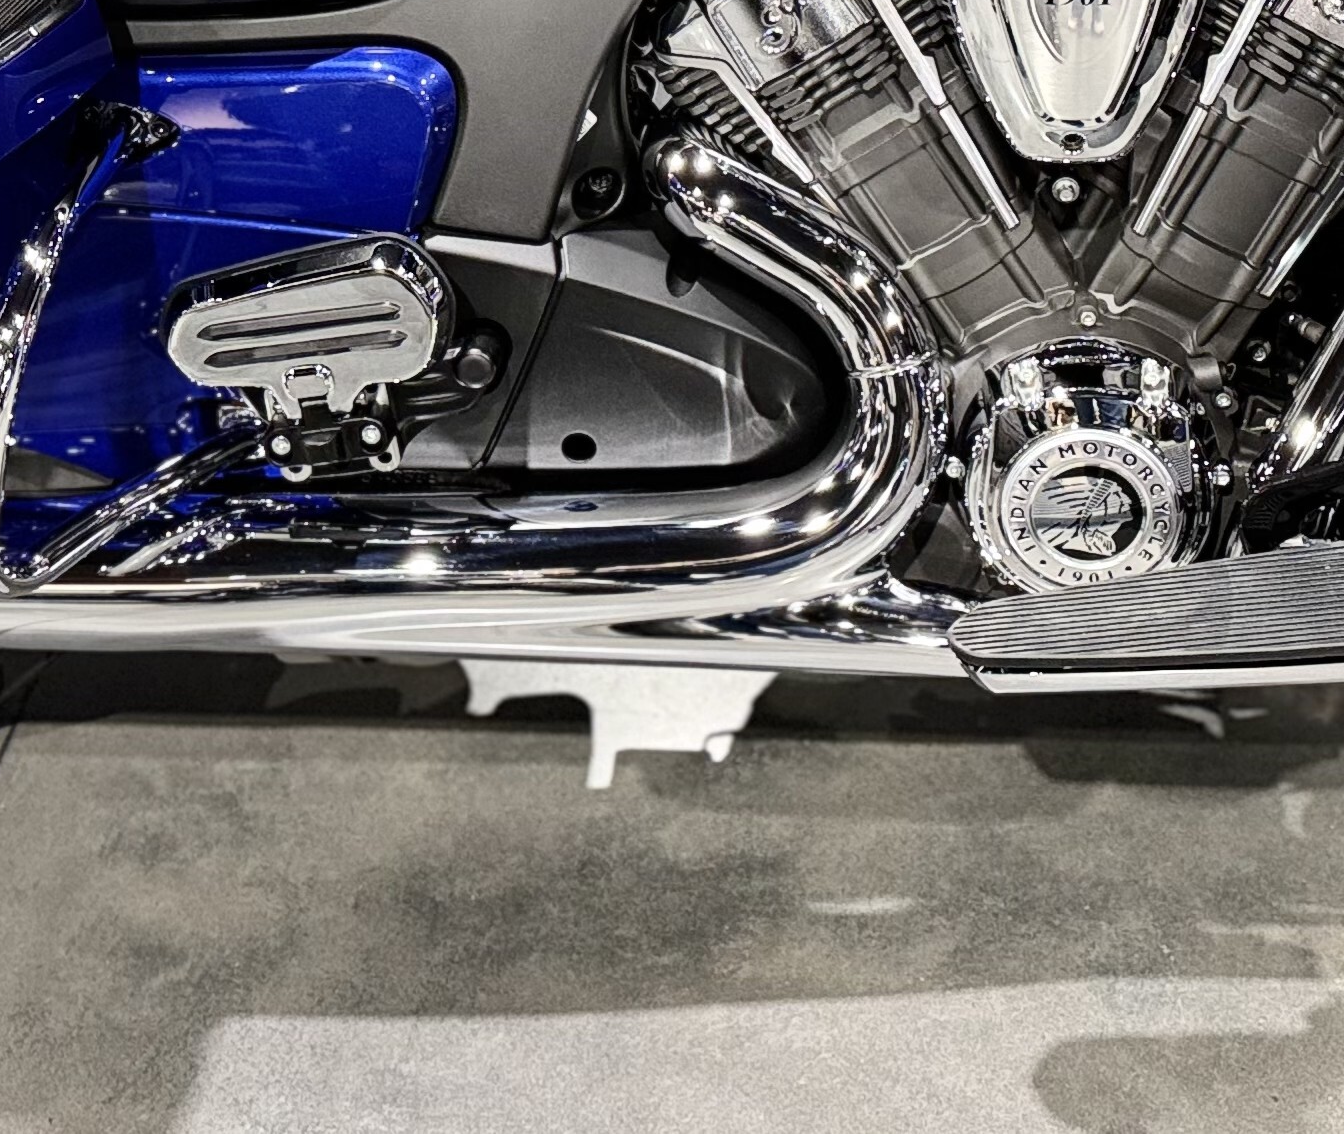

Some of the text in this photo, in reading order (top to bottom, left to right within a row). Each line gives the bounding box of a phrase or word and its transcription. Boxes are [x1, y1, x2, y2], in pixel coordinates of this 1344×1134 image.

[1010, 441, 1172, 562] INDIAN MOTORCYCLE
[1057, 567, 1115, 584] 1901
